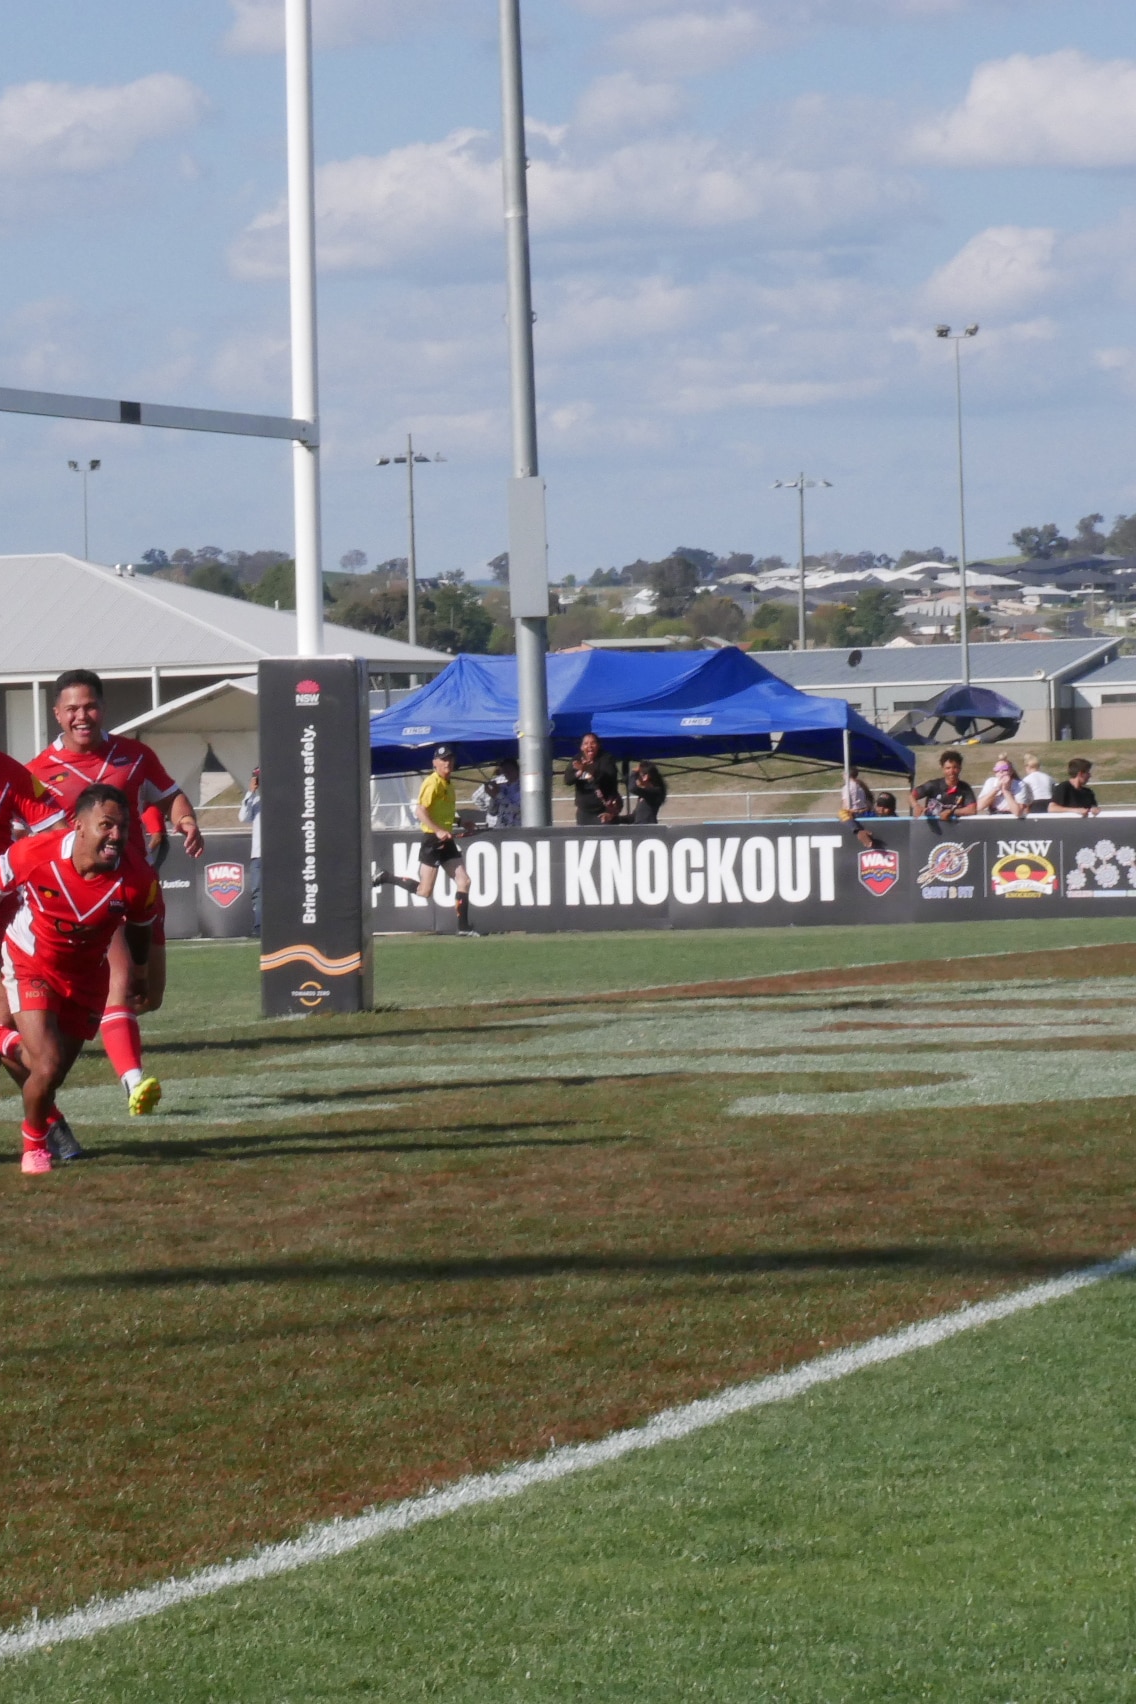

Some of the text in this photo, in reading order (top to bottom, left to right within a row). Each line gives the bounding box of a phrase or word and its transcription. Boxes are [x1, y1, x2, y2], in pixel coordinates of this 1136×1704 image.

[295, 693, 320, 703] NSW
[300, 724, 319, 924] Bring the mob home safely.
[996, 839, 1053, 858] NSW
[862, 852, 895, 868] WAC
[208, 866, 241, 881] WAC
[565, 836, 842, 906] KNOCKOUT
